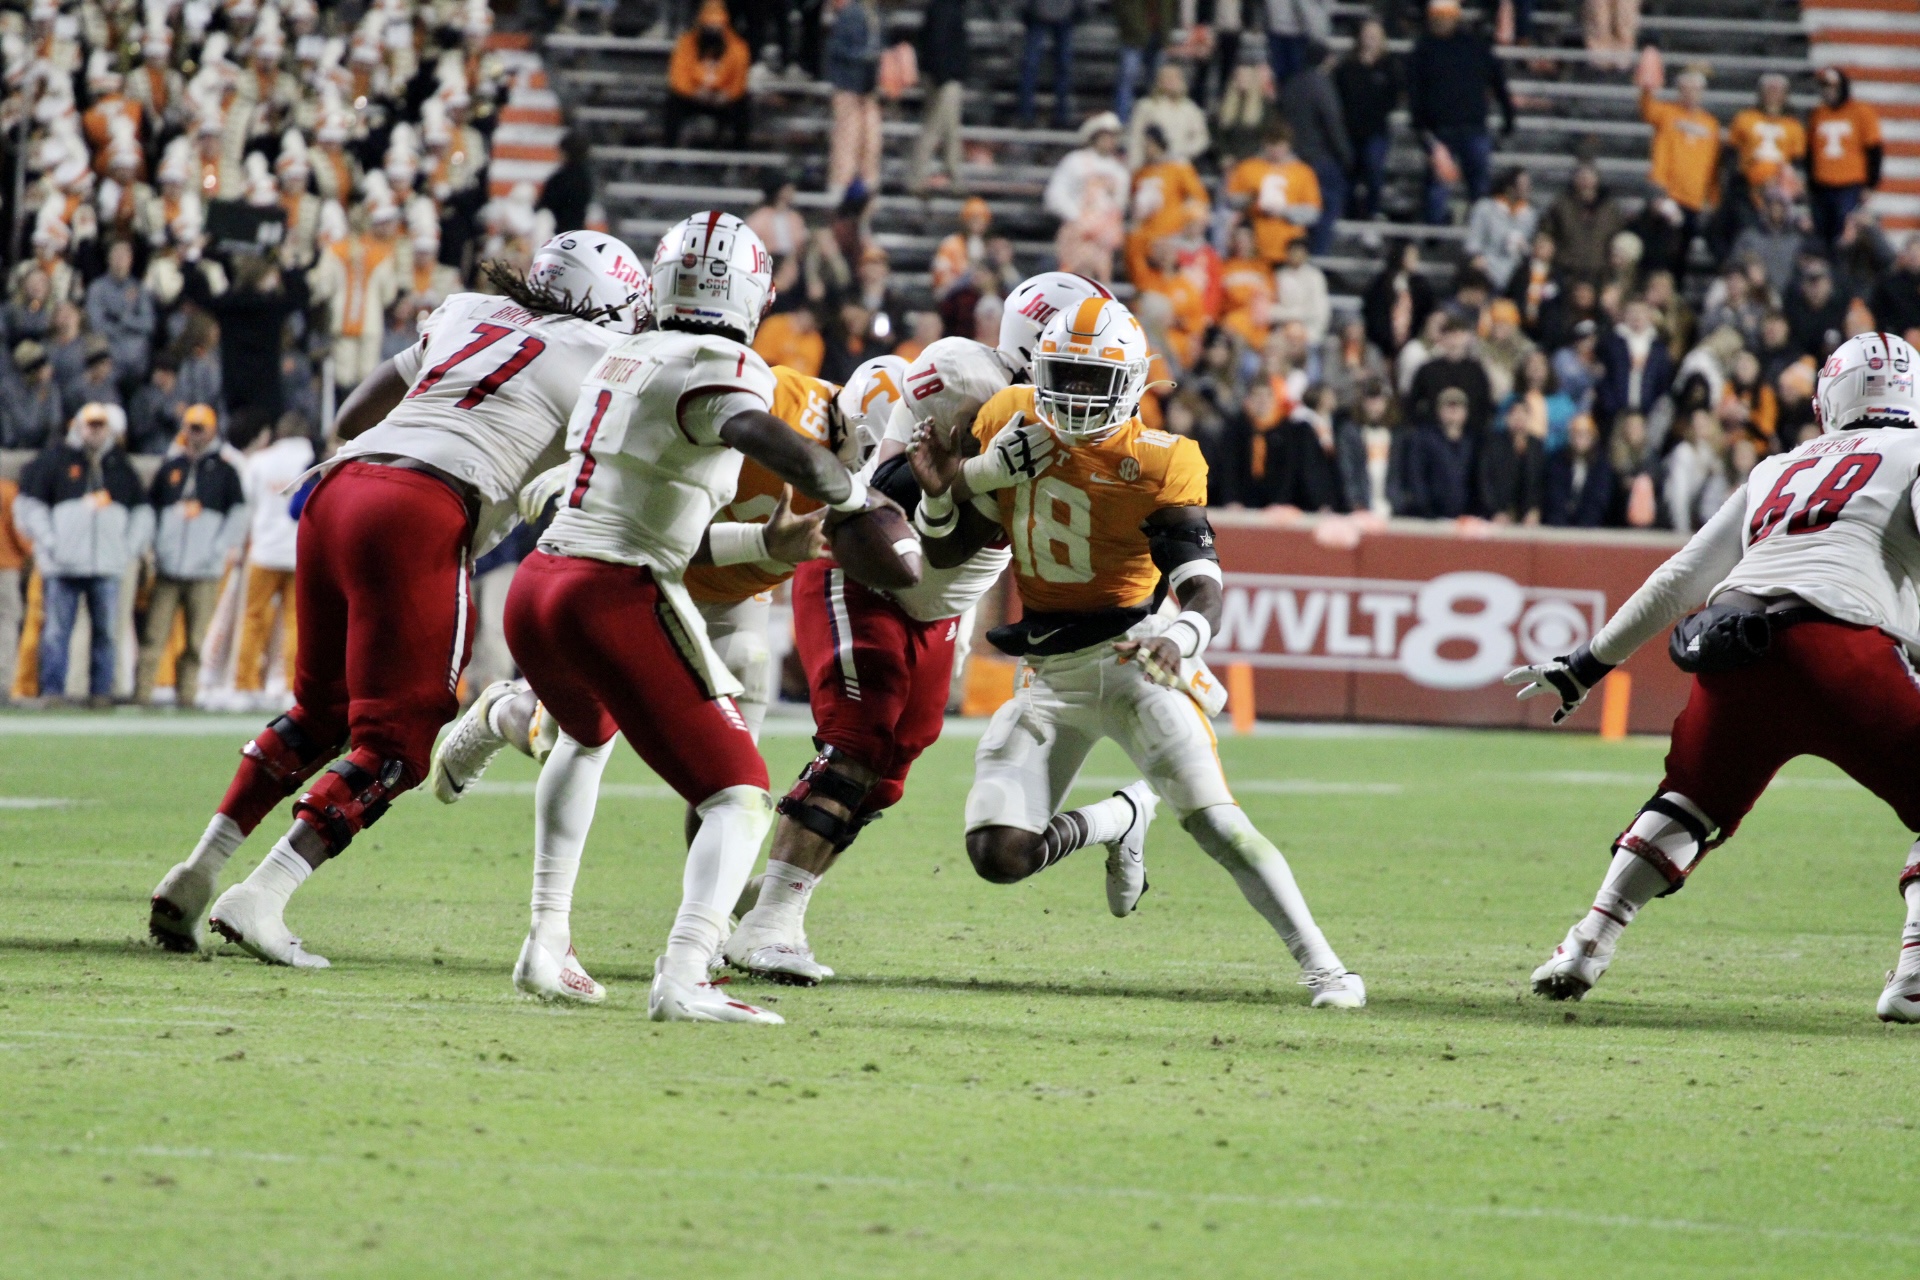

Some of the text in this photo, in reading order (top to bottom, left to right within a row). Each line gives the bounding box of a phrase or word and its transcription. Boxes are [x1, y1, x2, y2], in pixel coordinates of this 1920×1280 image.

[732, 350, 746, 378] 1
[907, 363, 945, 400] 78
[861, 369, 901, 416] T
[568, 389, 612, 508] 1
[1055, 450, 1071, 467] T
[1118, 457, 1141, 482] SEC
[1749, 453, 1882, 546] 68
[1012, 475, 1096, 583] 18
[1211, 570, 1524, 690] WVLT 8
